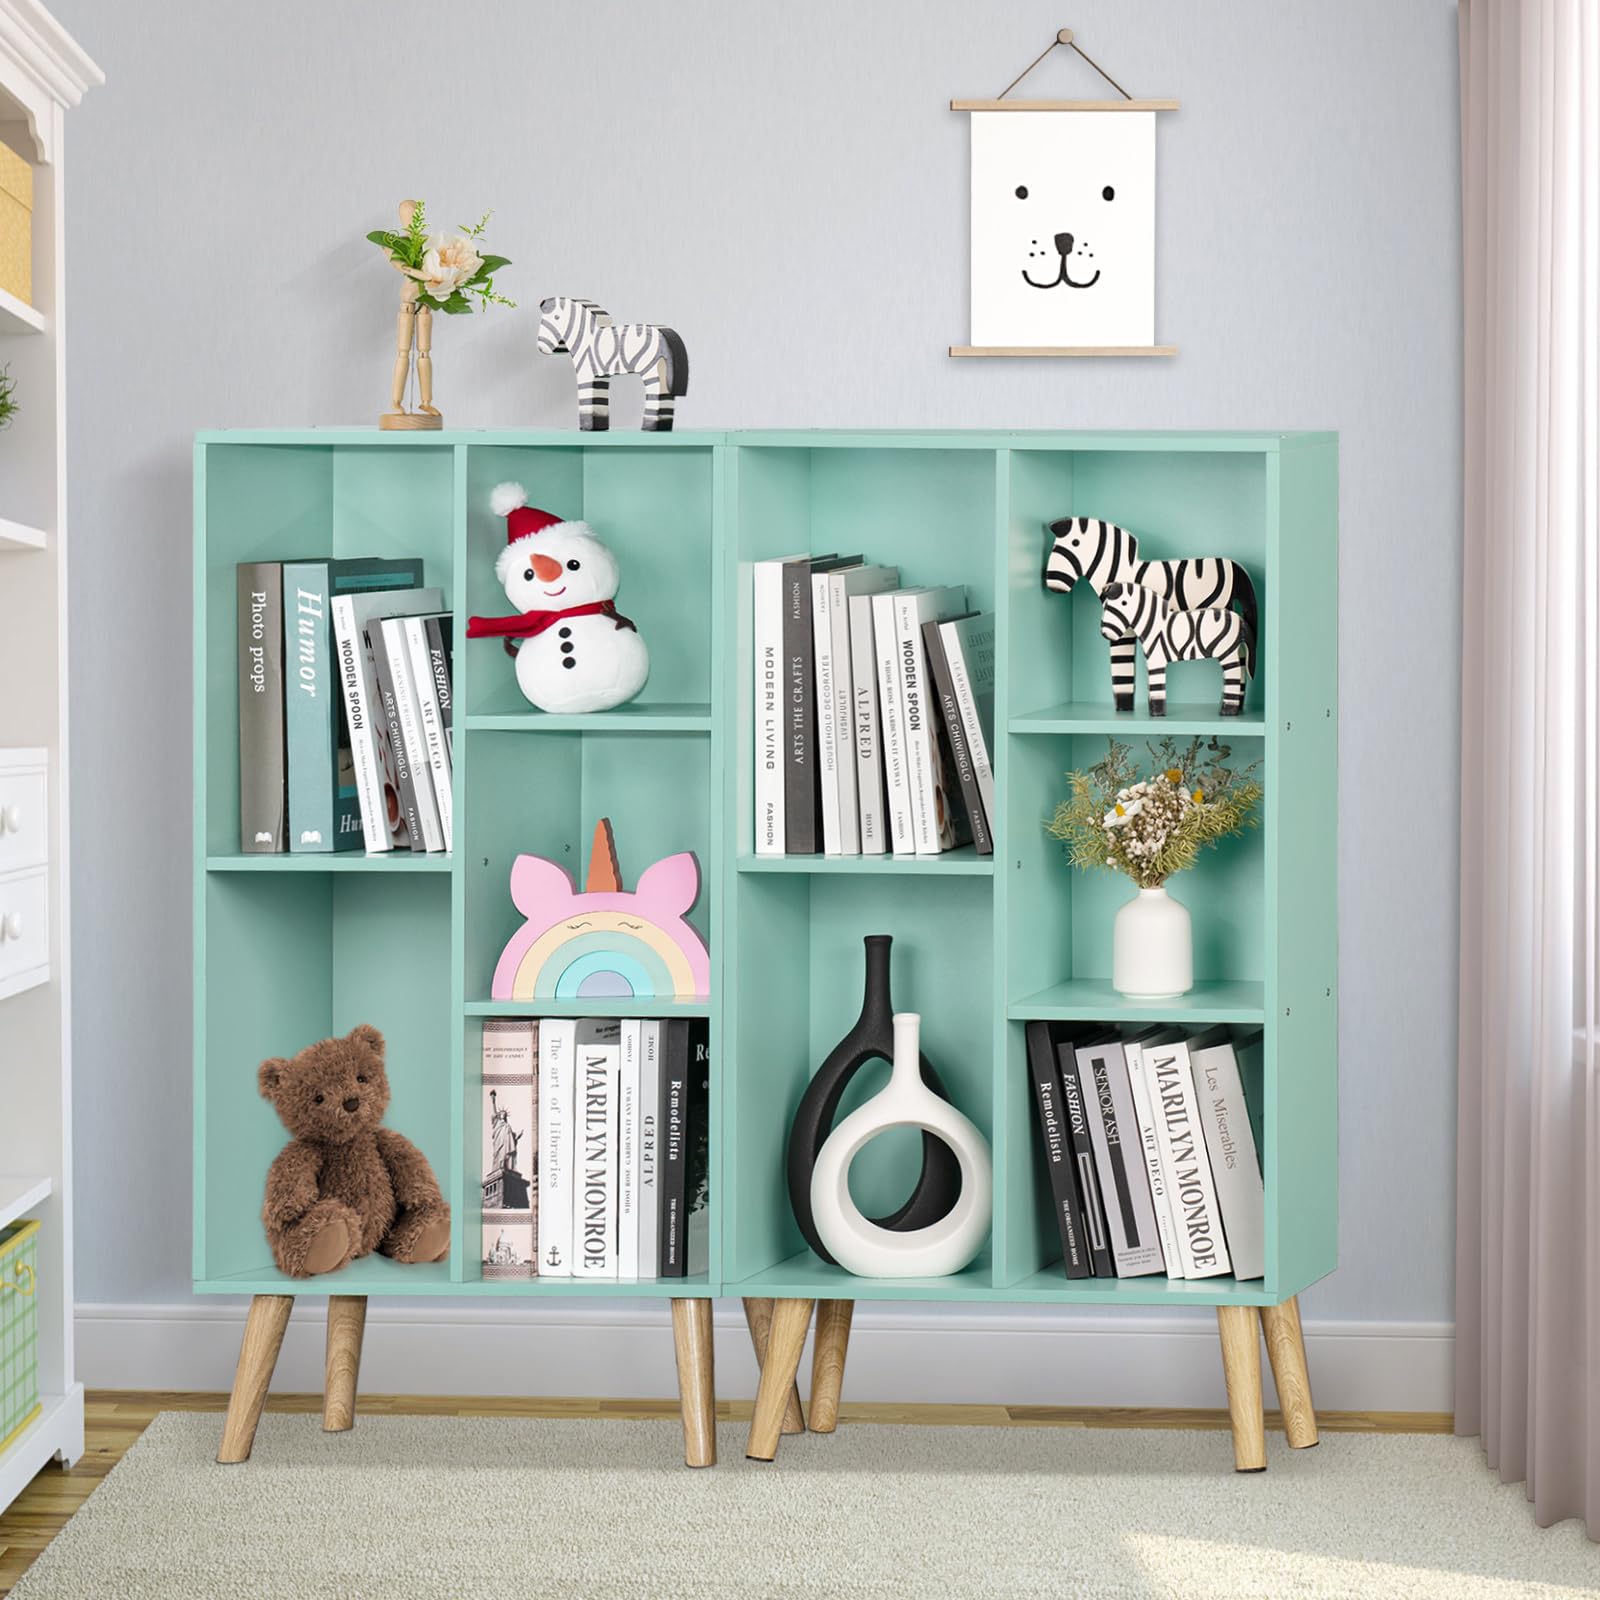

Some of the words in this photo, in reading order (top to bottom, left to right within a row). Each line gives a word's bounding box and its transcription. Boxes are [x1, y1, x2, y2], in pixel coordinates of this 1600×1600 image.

[250, 591, 267, 640] Photo
[297, 587, 322, 698] Humor
[341, 640, 357, 688] WOODEN
[902, 640, 919, 688] WOODEN
[249, 646, 265, 693] props
[430, 648, 451, 710] FASHION
[765, 647, 774, 711] MODERN
[793, 656, 803, 703] CRAFTS
[822, 655, 830, 713] DECORATES
[348, 690, 363, 730] SPOON
[384, 691, 398, 718] ARTS
[423, 699, 435, 726] ART
[793, 704, 804, 731] THE
[907, 690, 921, 731] SPOON
[953, 661, 969, 707] LEARNING
[963, 708, 975, 734] FROM
[766, 719, 775, 770] LIVING
[825, 715, 834, 771] HOUSEHOLD
[858, 687, 872, 759] ALPRED
[943, 694, 957, 721] ARTS
[950, 722, 971, 782] CHIWINGLO
[390, 719, 408, 779] CHIWINGLO
[428, 730, 442, 771] DECO
[794, 735, 805, 764] ARTS
[408, 807, 419, 841] FASHION
[973, 810, 985, 843] FASHION
[550, 1037, 562, 1062] The
[551, 1067, 561, 1089] art
[1094, 1067, 1115, 1117] SENIOR
[551, 1097, 562, 1116] of
[585, 1056, 607, 1163] MARILYN
[669, 1081, 681, 1161] Remodelista
[1040, 1082, 1062, 1163] Remodelista
[1063, 1074, 1085, 1135] FASHION
[1205, 1067, 1219, 1092] Les
[1212, 1098, 1237, 1170] Miserables
[644, 1115, 655, 1187] ALPRED
[1104, 1116, 1120, 1145] ASH
[1143, 1126, 1157, 1154] ART
[550, 1121, 561, 1189] libraries
[1149, 1158, 1164, 1197] DECO
[1154, 1056, 1197, 1163] MARILYN
[1176, 1169, 1217, 1270] MONROE
[584, 1169, 607, 1269] MONROE
[669, 1211, 677, 1248] ORGANIZED
[1064, 1212, 1076, 1248] ORGANIZED
